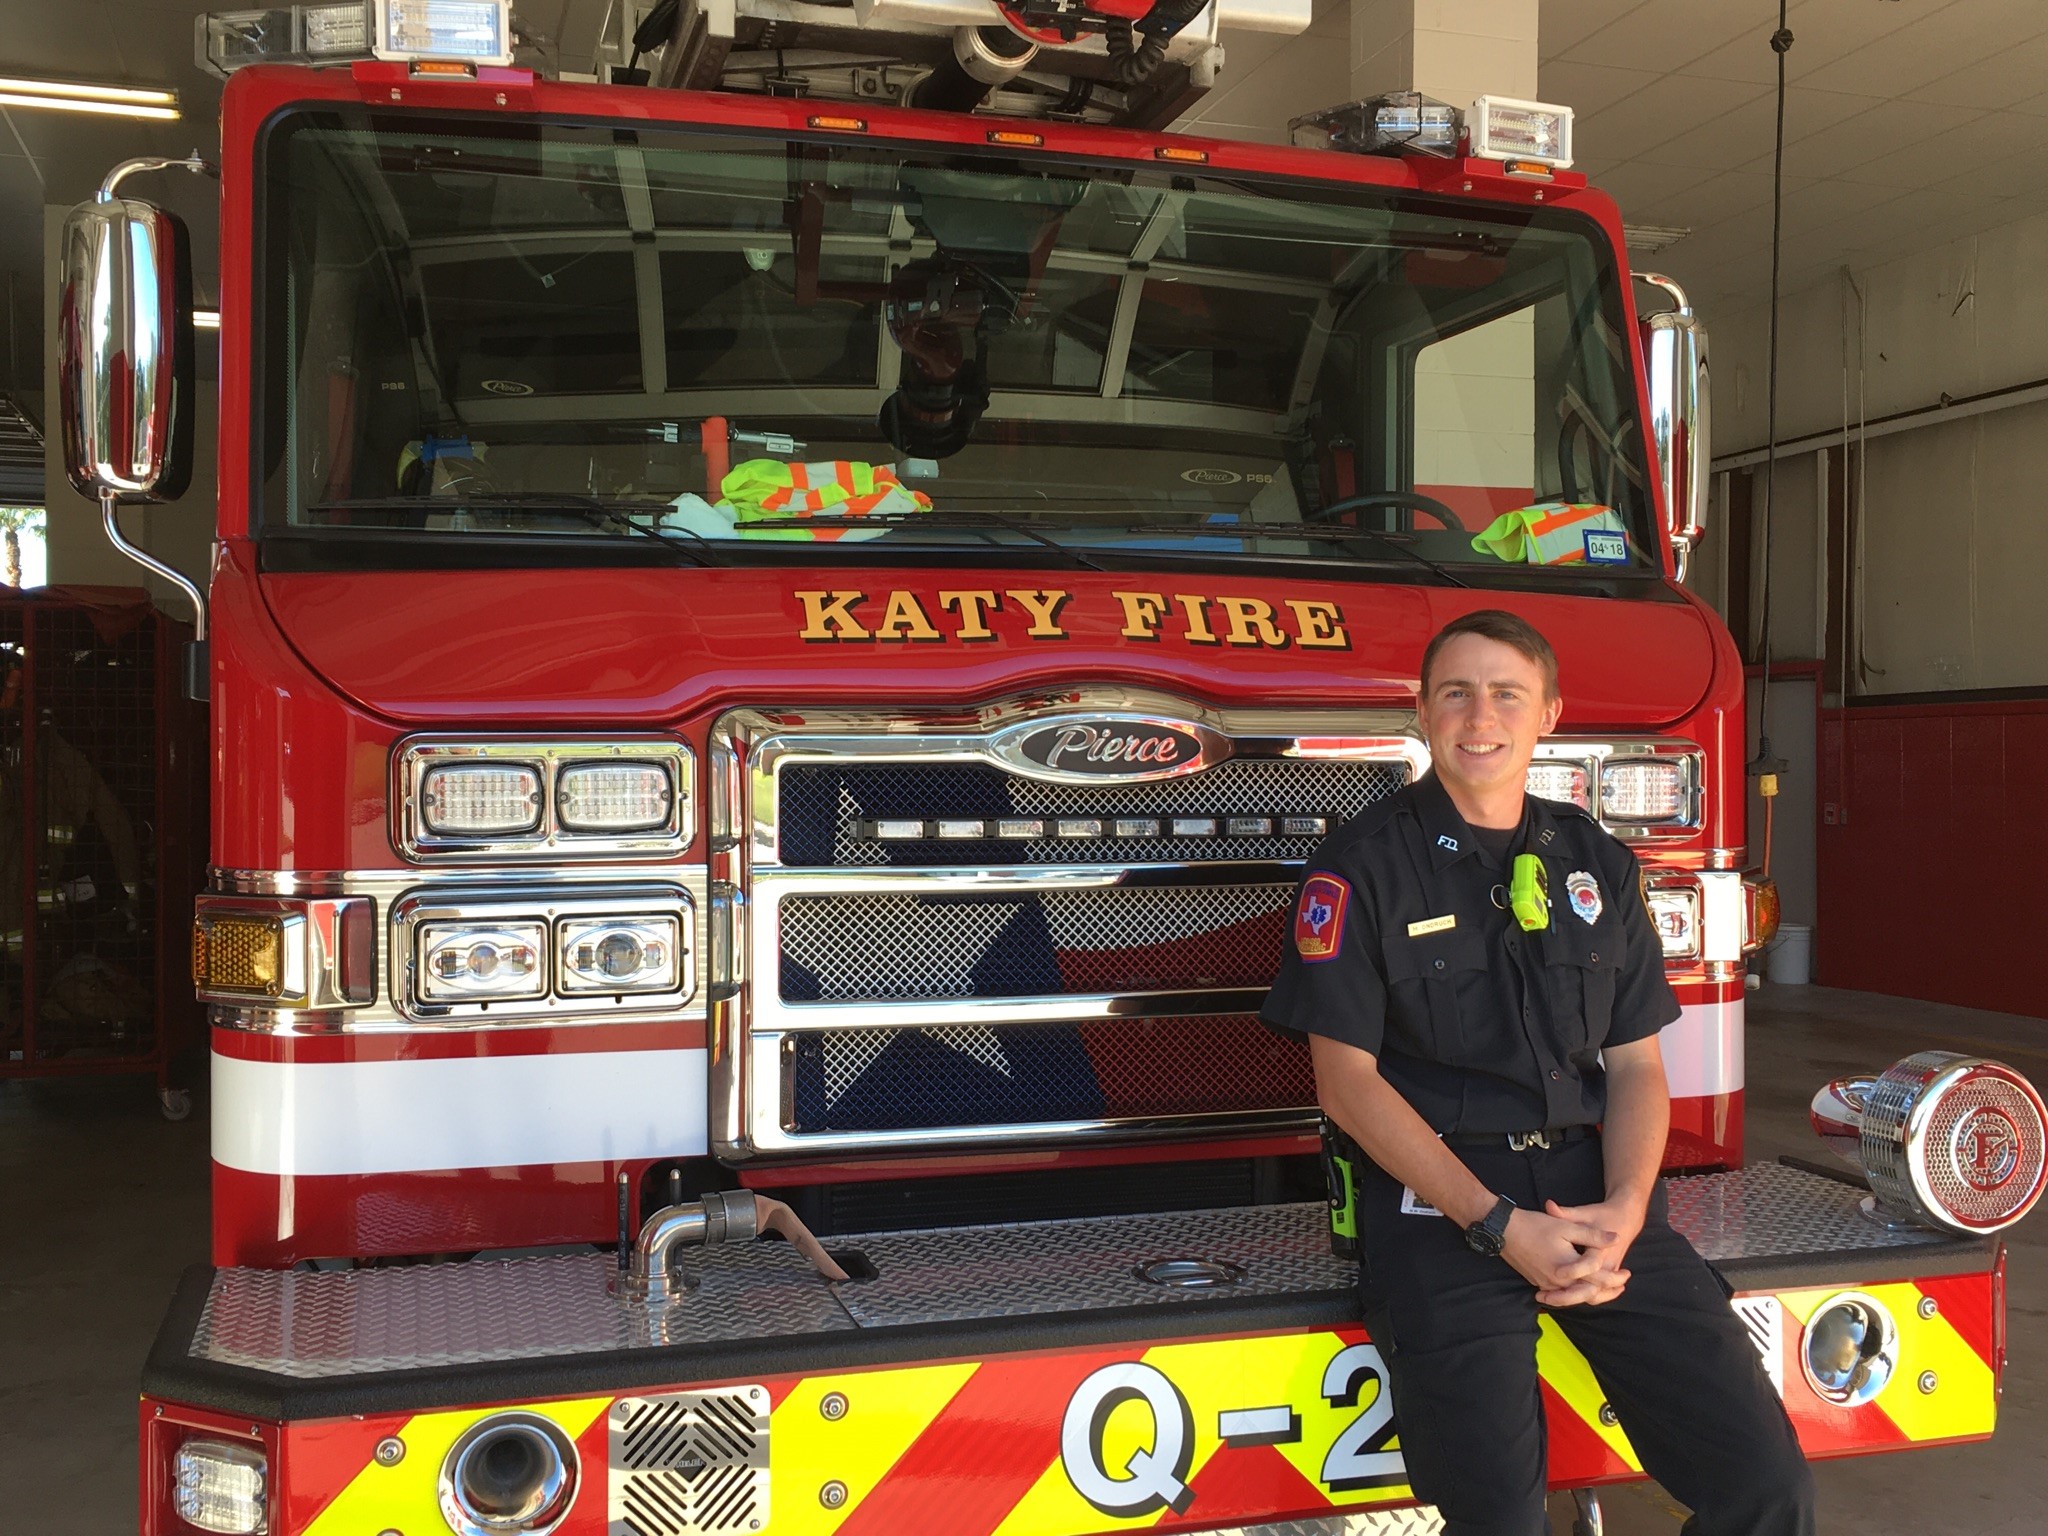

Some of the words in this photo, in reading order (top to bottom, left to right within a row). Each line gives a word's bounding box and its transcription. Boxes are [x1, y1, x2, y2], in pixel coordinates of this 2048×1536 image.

[1195, 470, 1228, 481] Pierce
[793, 590, 1074, 643] KATY
[1111, 591, 1353, 651] FIRE
[1045, 724, 1179, 768] Pierce
[1437, 834, 1459, 852] FD
[1060, 1343, 1411, 1518] Q-2
